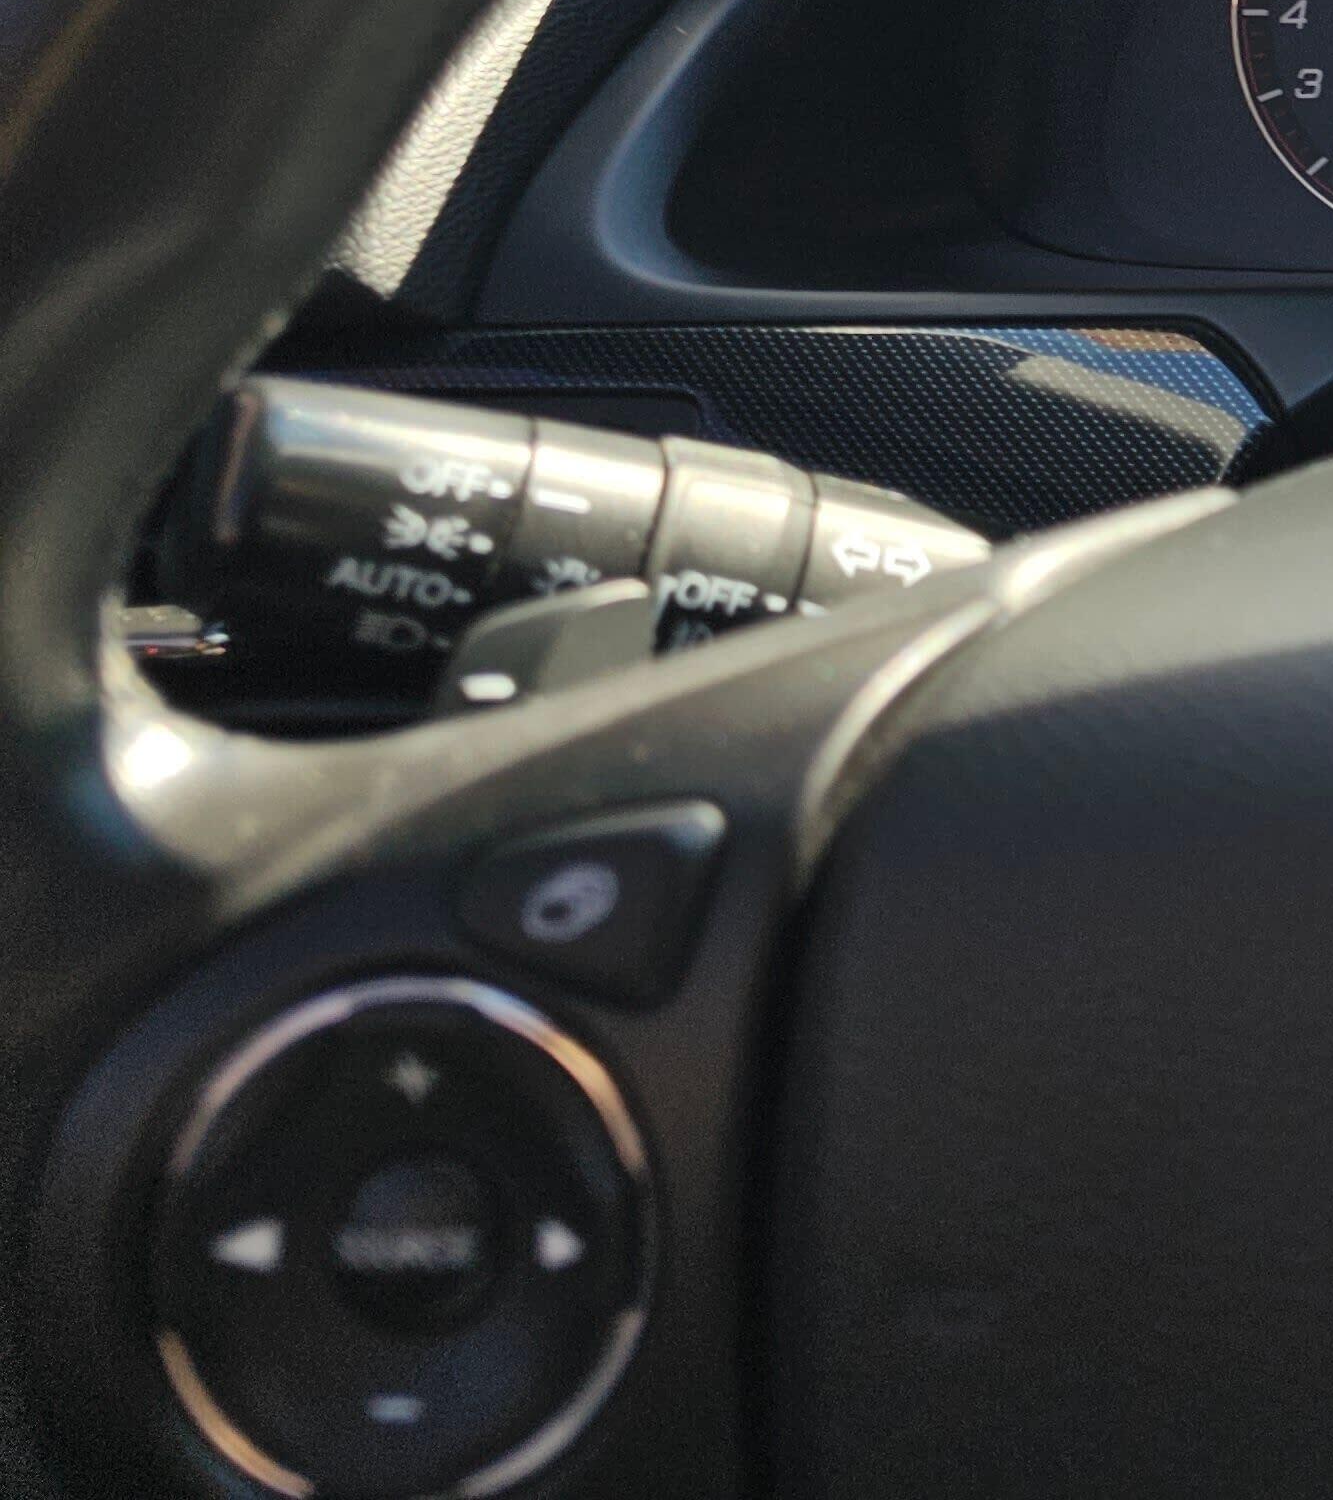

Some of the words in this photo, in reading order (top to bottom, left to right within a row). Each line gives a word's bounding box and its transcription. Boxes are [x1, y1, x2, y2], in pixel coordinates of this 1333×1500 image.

[1280, 0, 1307, 29] 4
[1295, 69, 1323, 98] 3
[329, 558, 454, 606] AUTO
